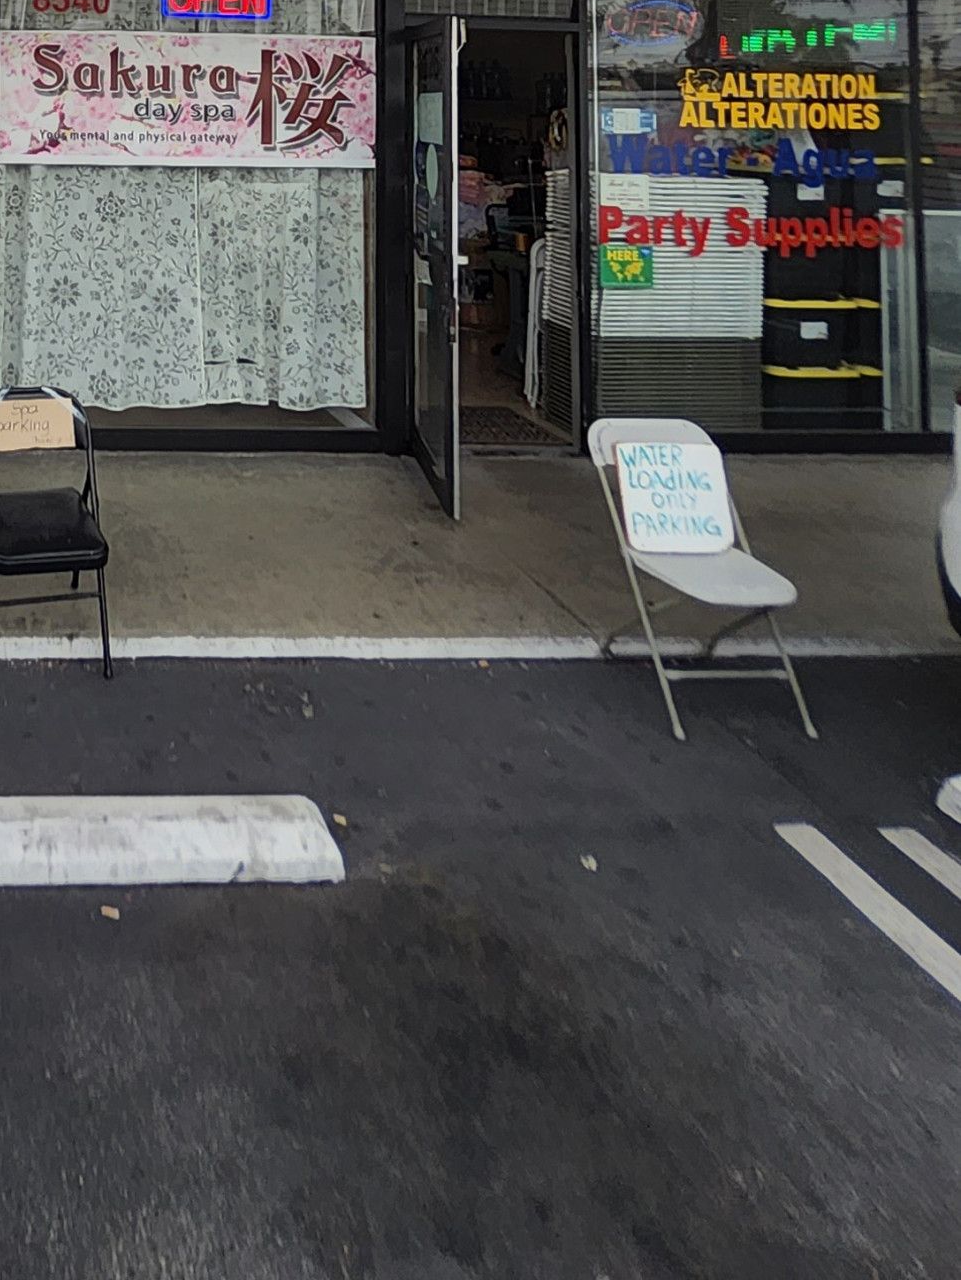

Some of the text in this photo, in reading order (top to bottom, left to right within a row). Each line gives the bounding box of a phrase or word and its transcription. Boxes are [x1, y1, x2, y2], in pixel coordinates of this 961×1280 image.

[607, 7, 699, 38] OPEN
[32, 44, 240, 96] Sakura
[721, 73, 876, 99] ALTERATION
[134, 98, 237, 126] day spa
[244, 49, 356, 151] 桜
[679, 103, 881, 130] ALTERATIONES
[70, 129, 110, 142] mental
[113, 131, 134, 142] and
[138, 130, 187, 144] physical
[190, 132, 238, 146] gateway
[608, 132, 731, 177] Water
[773, 138, 876, 188] Agua
[599, 205, 904, 258] Party Supplies
[606, 249, 639, 262] HERE
[619, 444, 684, 468] WATER
[631, 511, 723, 537] PARKING
